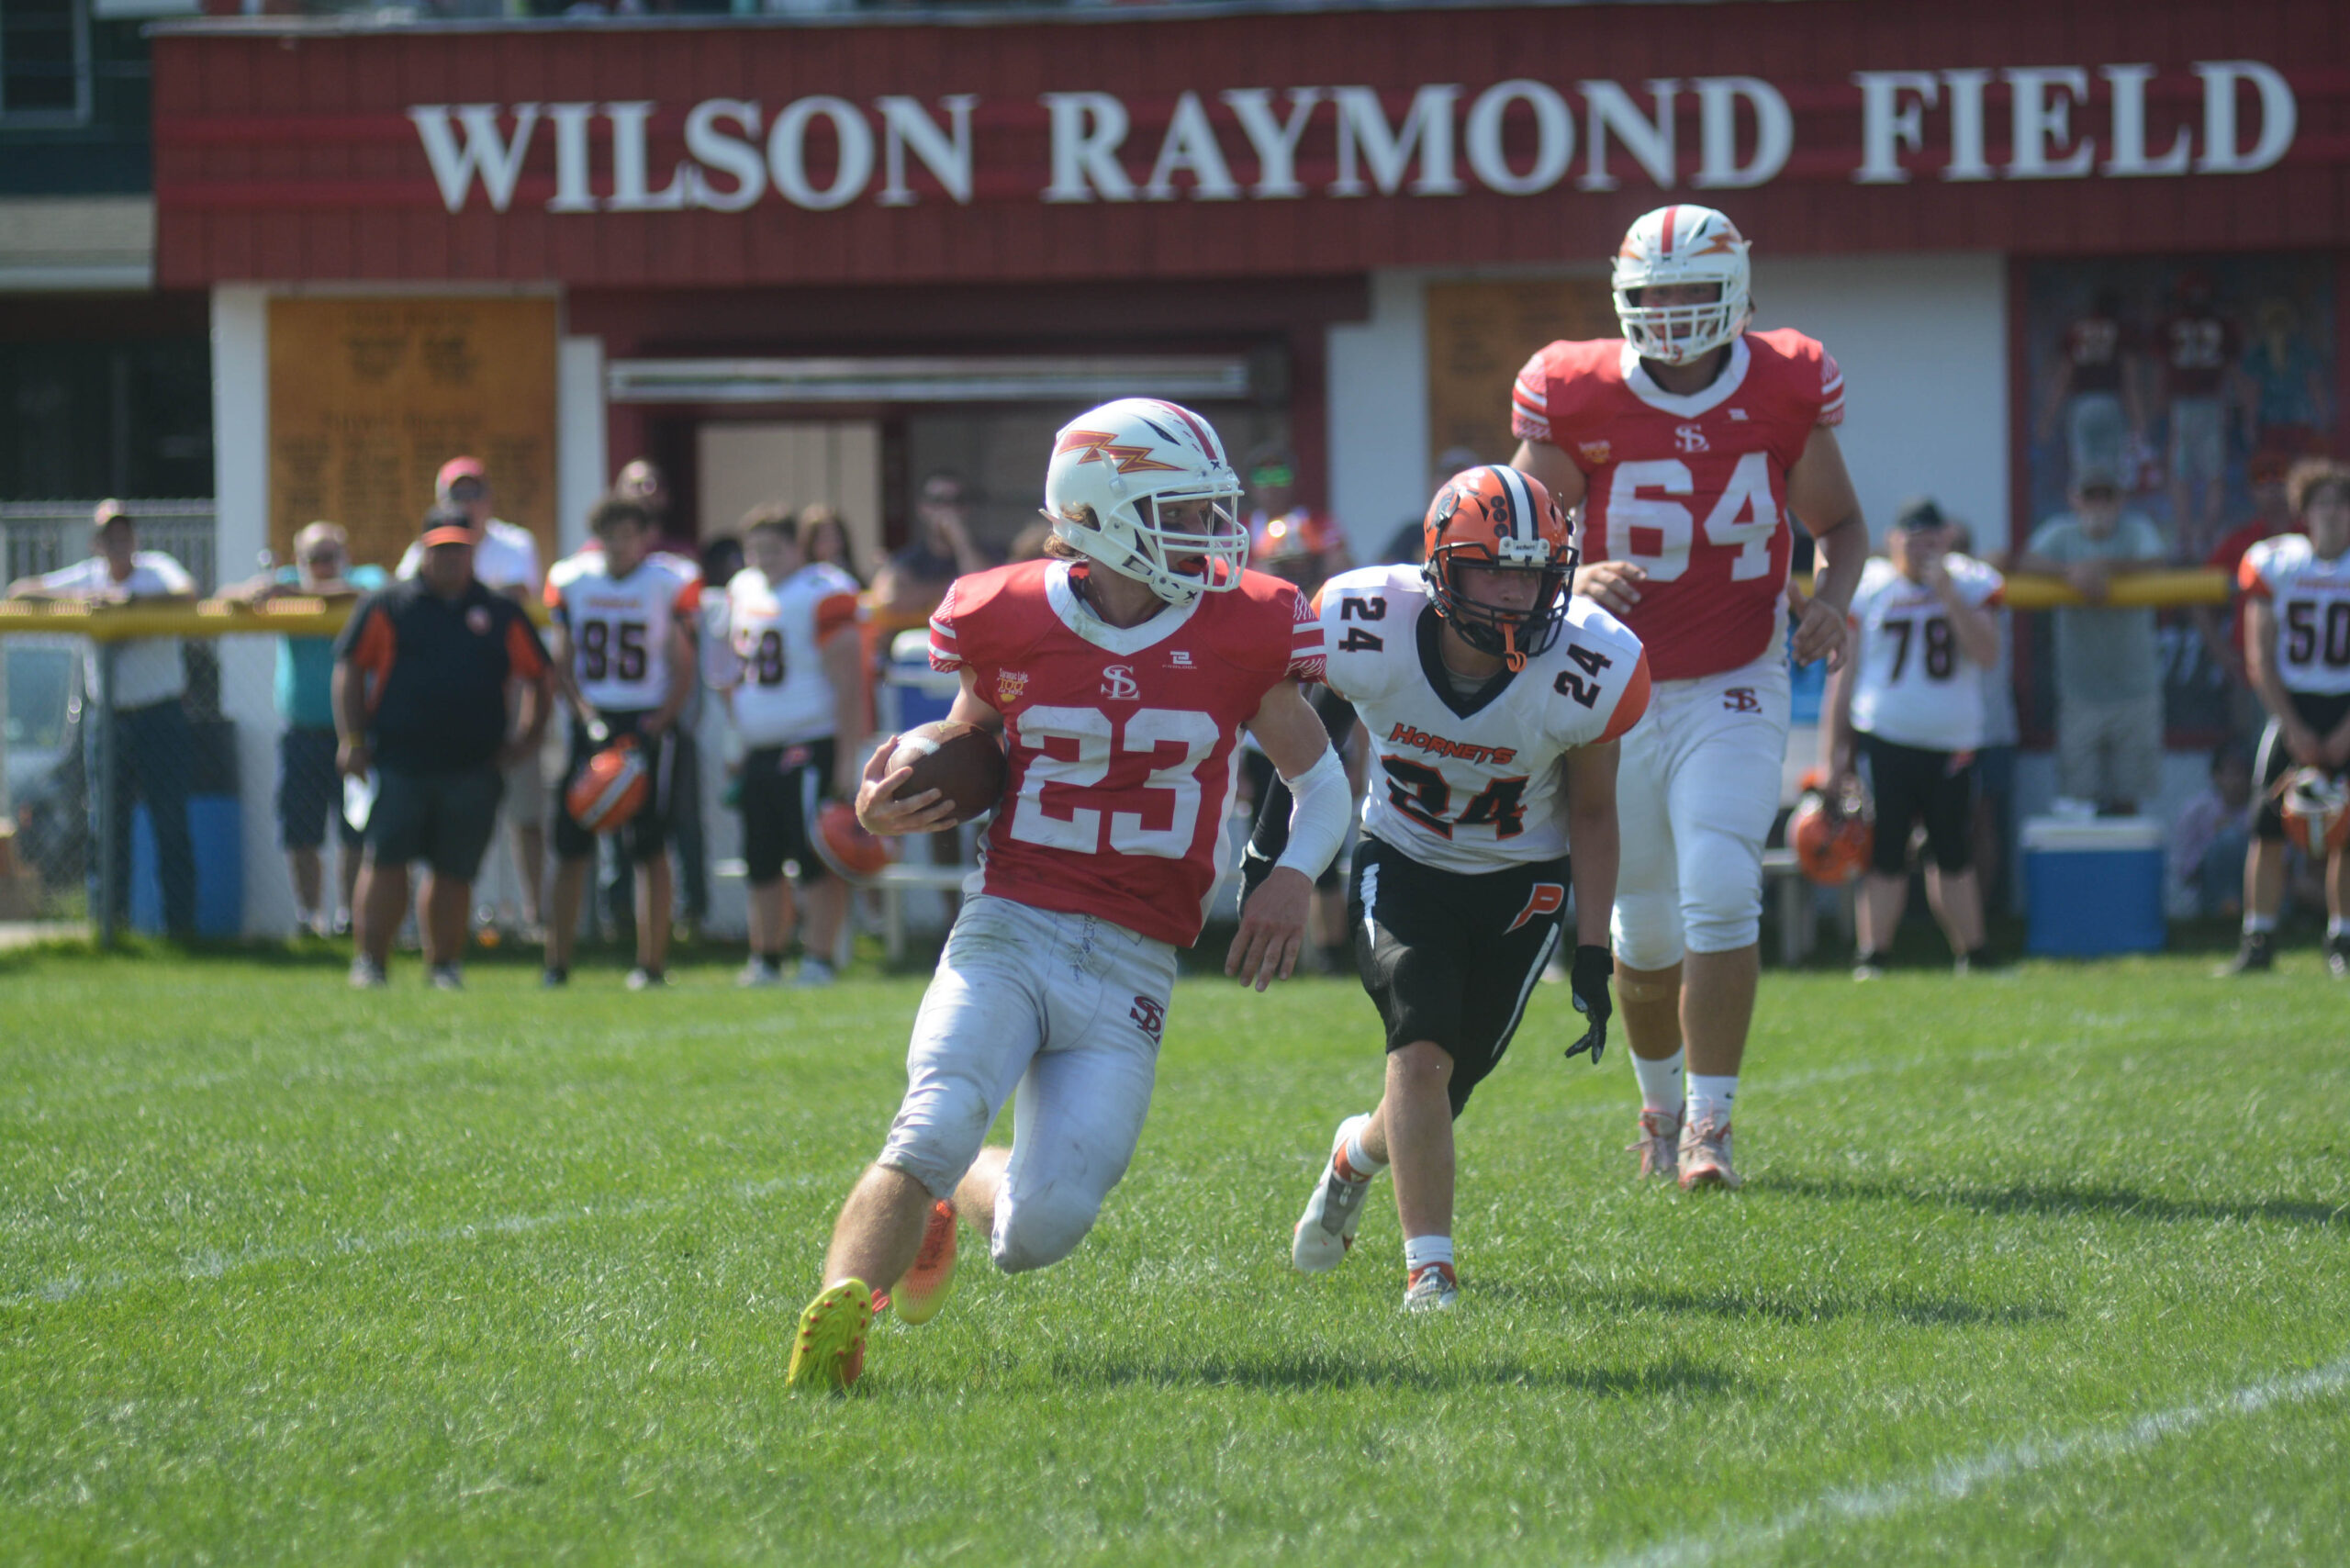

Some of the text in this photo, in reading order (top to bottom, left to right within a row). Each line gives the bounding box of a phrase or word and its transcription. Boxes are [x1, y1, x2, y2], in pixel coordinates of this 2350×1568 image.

[406, 60, 2299, 214] WILSON RAYMOND FIELD
[1606, 452, 1778, 583] 64
[584, 621, 647, 681] 85
[1338, 597, 1387, 653] 24
[1884, 618, 1956, 684] 78
[2288, 600, 2350, 666] 50
[1553, 644, 1613, 710] 24
[1388, 722, 1517, 766] HORNETS
[1011, 704, 1220, 859] 23
[1381, 755, 1530, 841] 24
[1503, 882, 1564, 935] P
